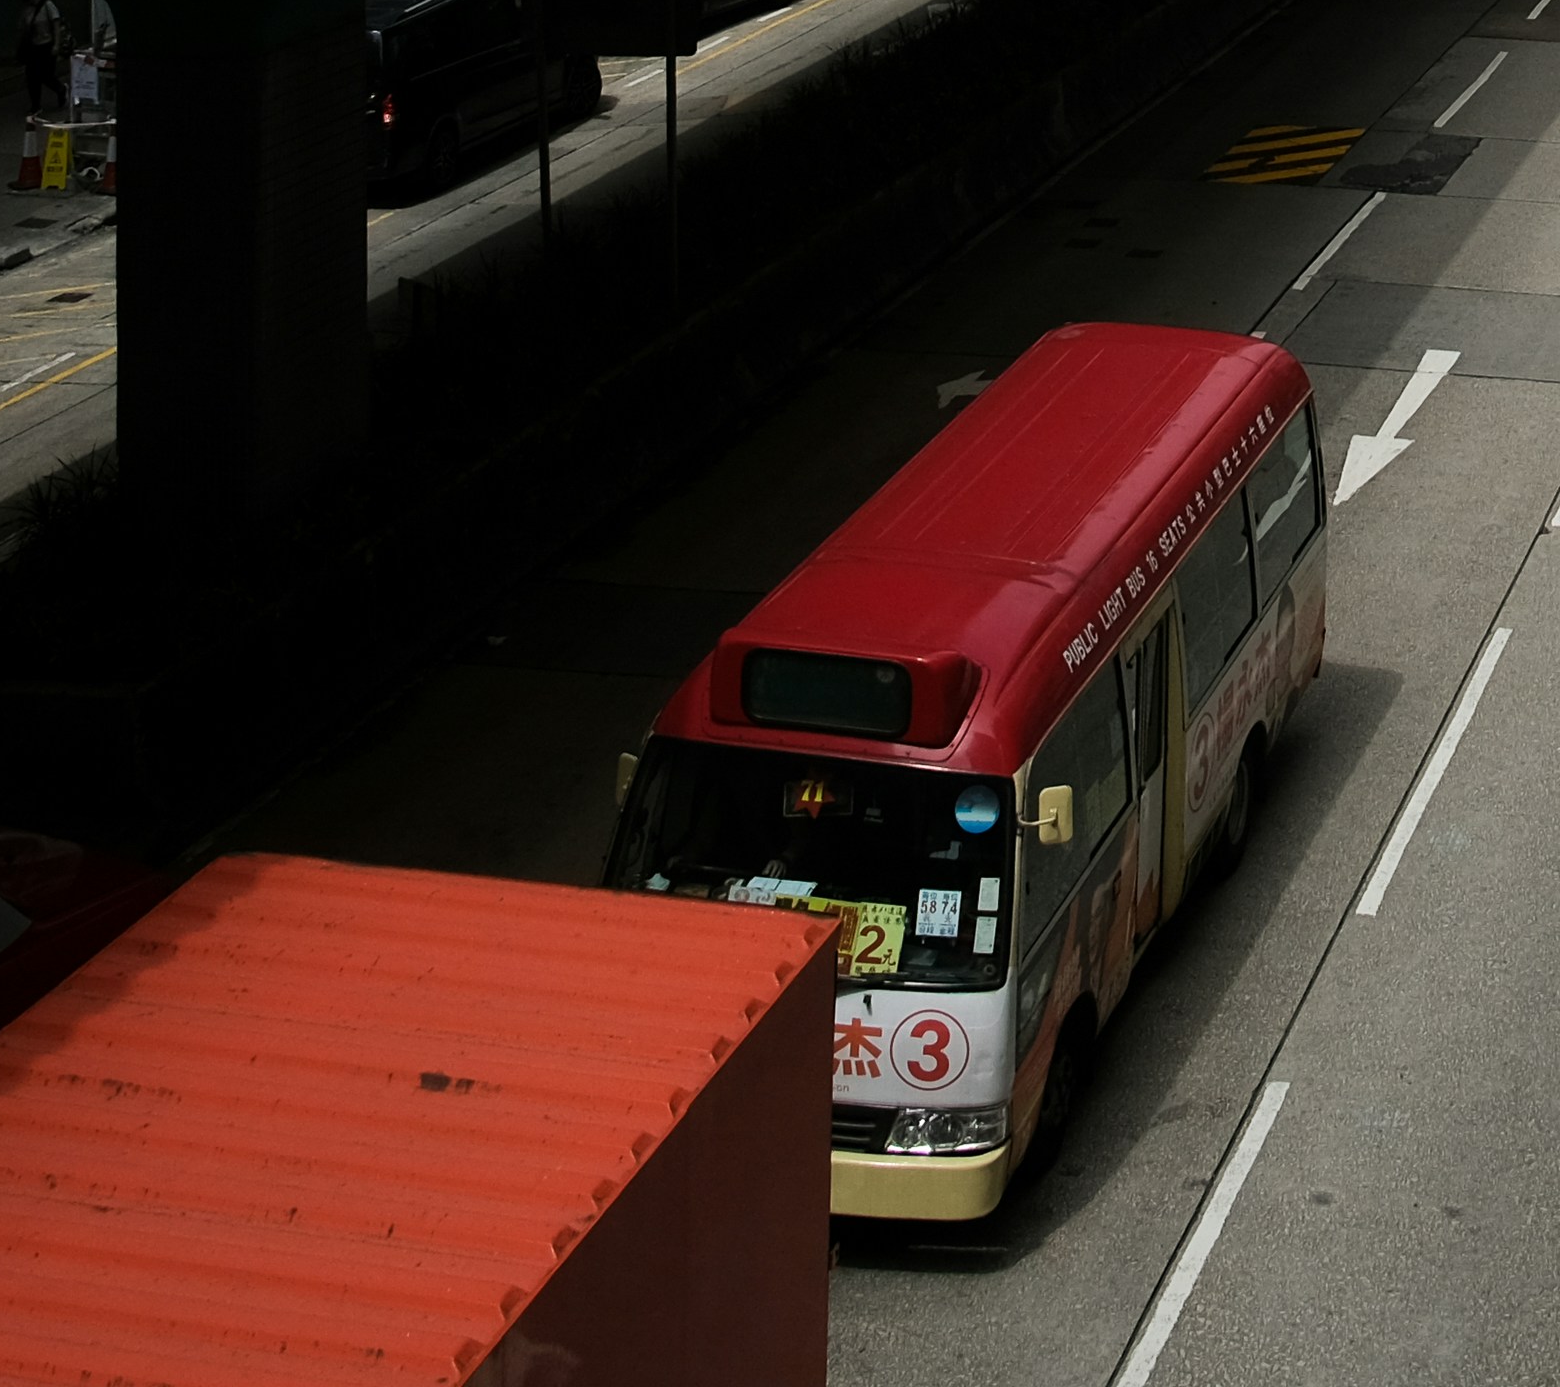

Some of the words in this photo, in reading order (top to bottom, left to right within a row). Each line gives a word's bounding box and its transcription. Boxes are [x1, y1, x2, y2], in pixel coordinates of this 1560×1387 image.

[1062, 622, 1100, 674] PUBLIC
[1097, 585, 1128, 631] LIGHT
[1125, 565, 1147, 600] BUS
[1145, 549, 1159, 574] 16
[1158, 514, 1188, 558] SEATS
